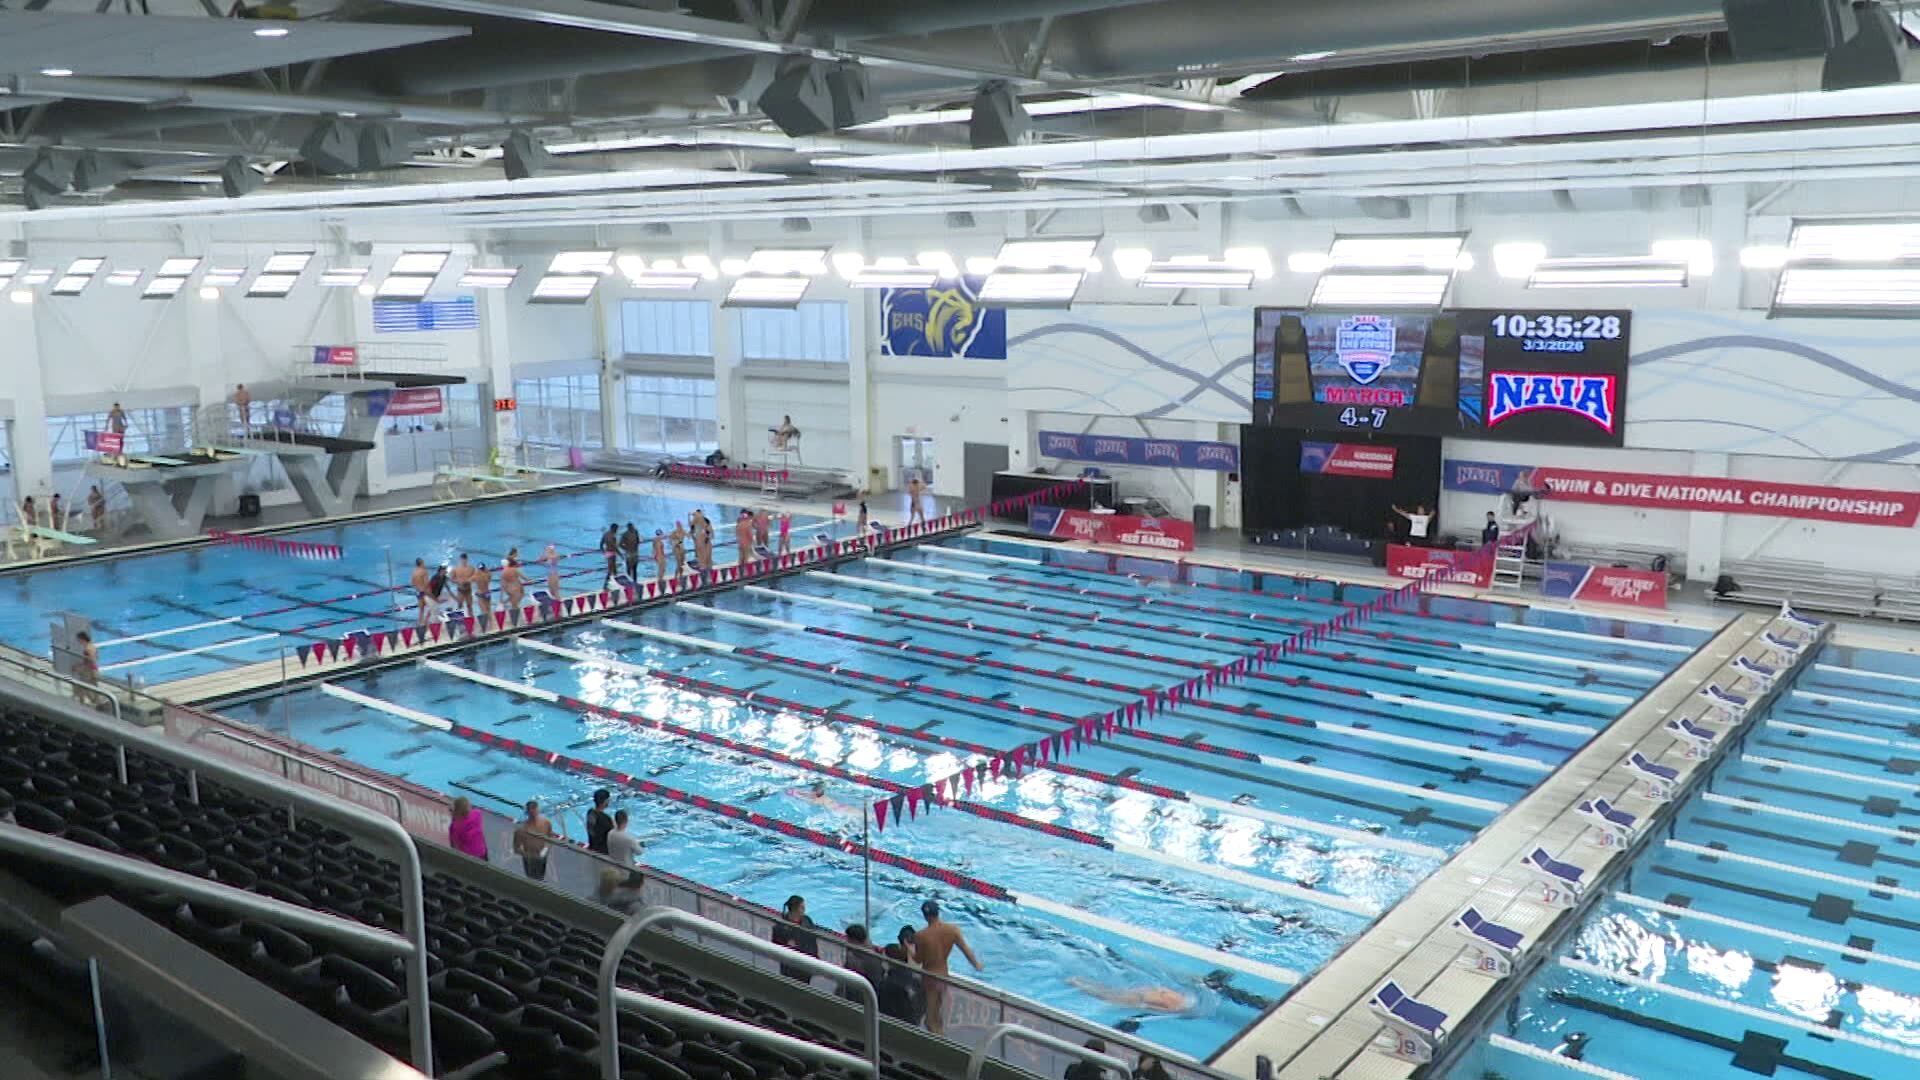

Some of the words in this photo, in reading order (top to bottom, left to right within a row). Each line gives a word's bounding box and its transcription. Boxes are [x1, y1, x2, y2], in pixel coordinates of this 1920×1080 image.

[893, 312, 924, 332] EHS
[1491, 314, 1621, 339] 10:35:28
[1325, 385, 1405, 407] MARCH
[1490, 374, 1615, 431] NAIA
[1456, 465, 1503, 489] NAIA
[1544, 476, 1590, 496] SWIM
[1592, 481, 1608, 496] &
[1610, 481, 1653, 499] DIVE
[1654, 484, 1745, 505] NATIONAL
[1749, 490, 1905, 517] CHAMPIONSHIP
